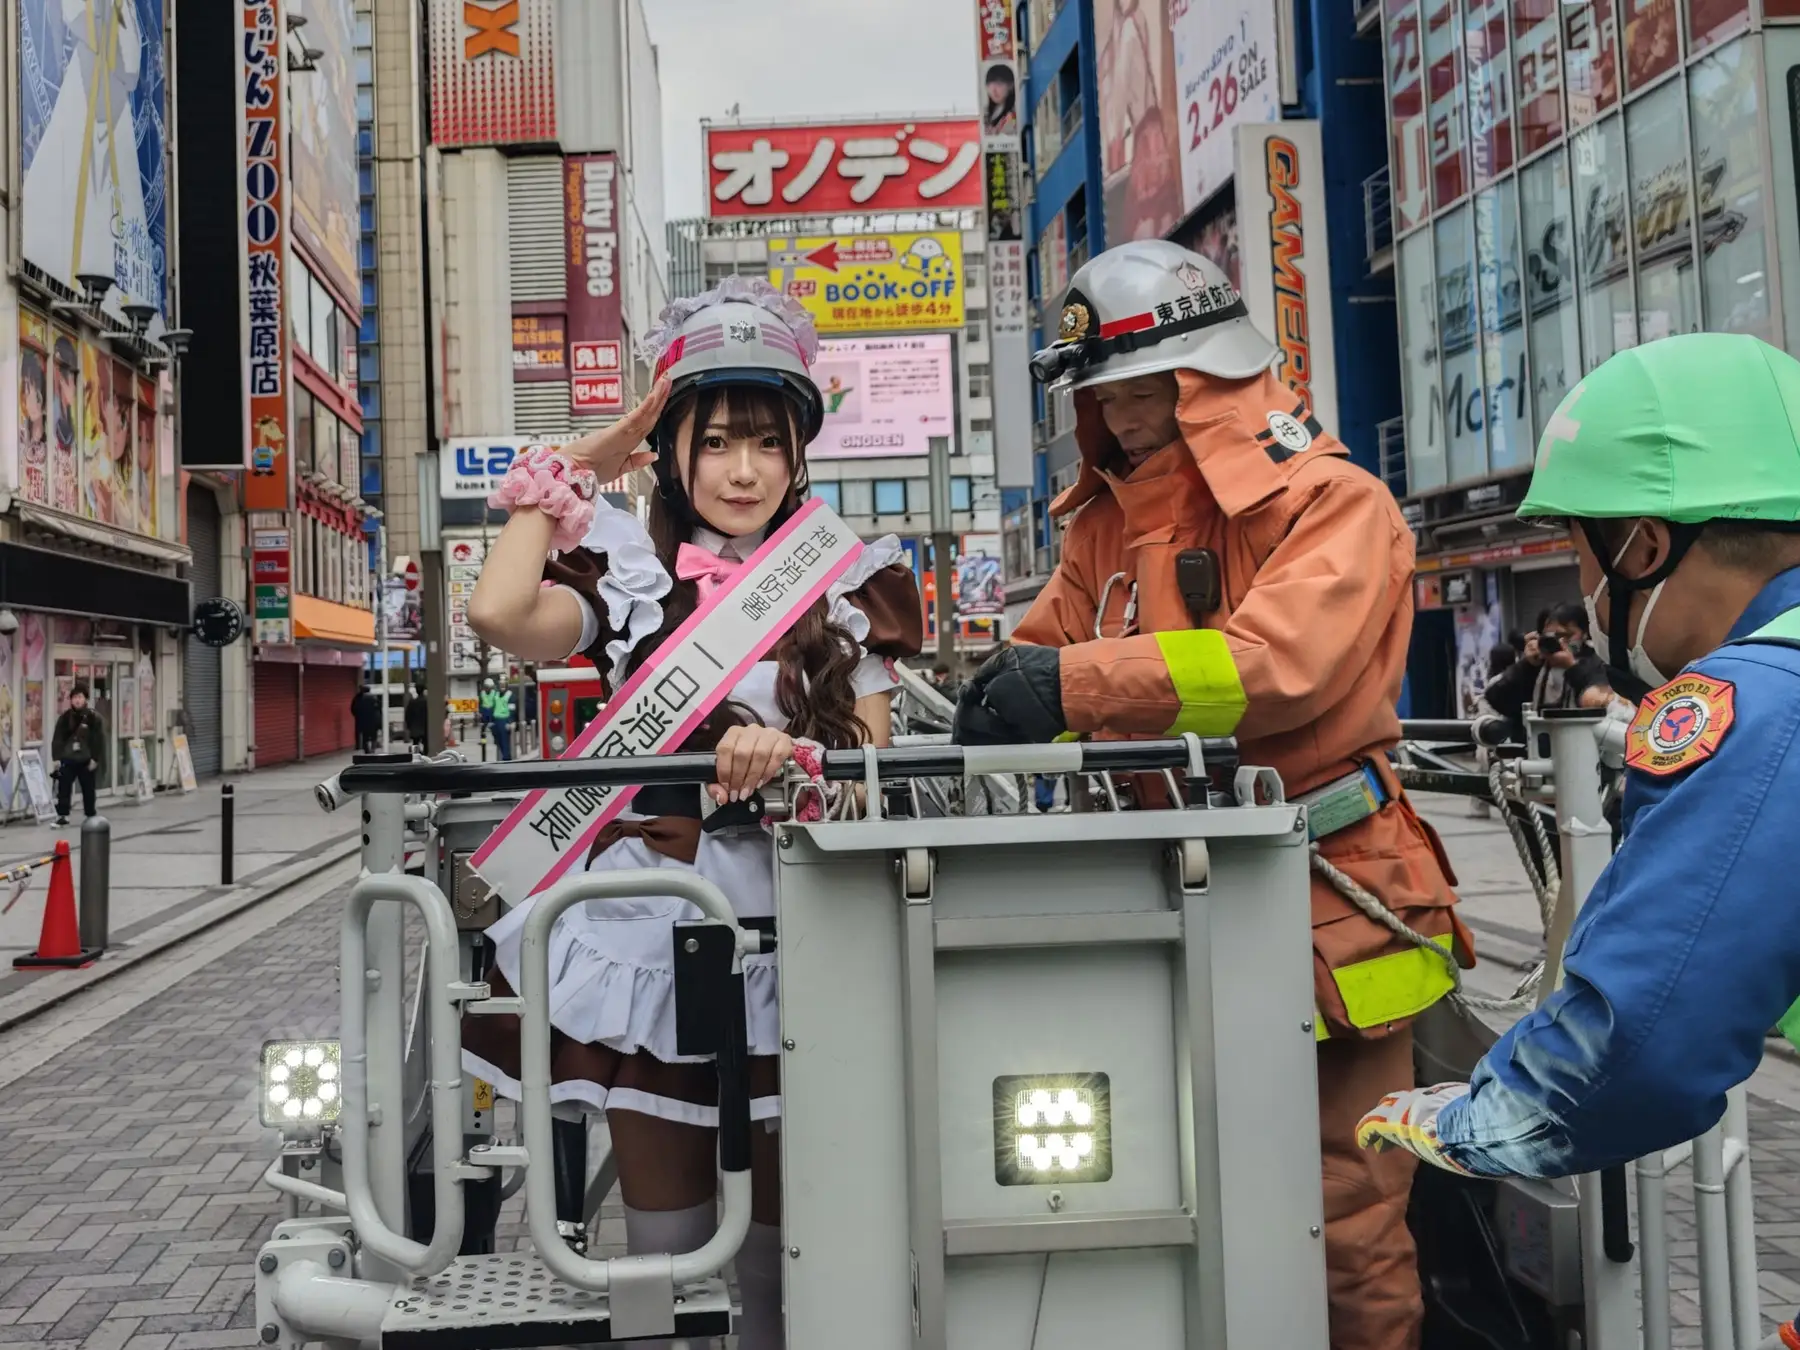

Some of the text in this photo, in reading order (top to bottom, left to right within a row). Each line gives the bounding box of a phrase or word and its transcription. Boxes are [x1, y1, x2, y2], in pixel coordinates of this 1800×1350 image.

[1238, 41, 1258, 76] ON
[1240, 58, 1267, 102] SALE
[1187, 61, 1238, 152] 2.26
[712, 124, 980, 205] オノデン
[571, 224, 584, 266] Store
[582, 161, 616, 298] Duty Free
[742, 525, 838, 621] 神田消防署
[1663, 683, 1694, 700] TOKYO
